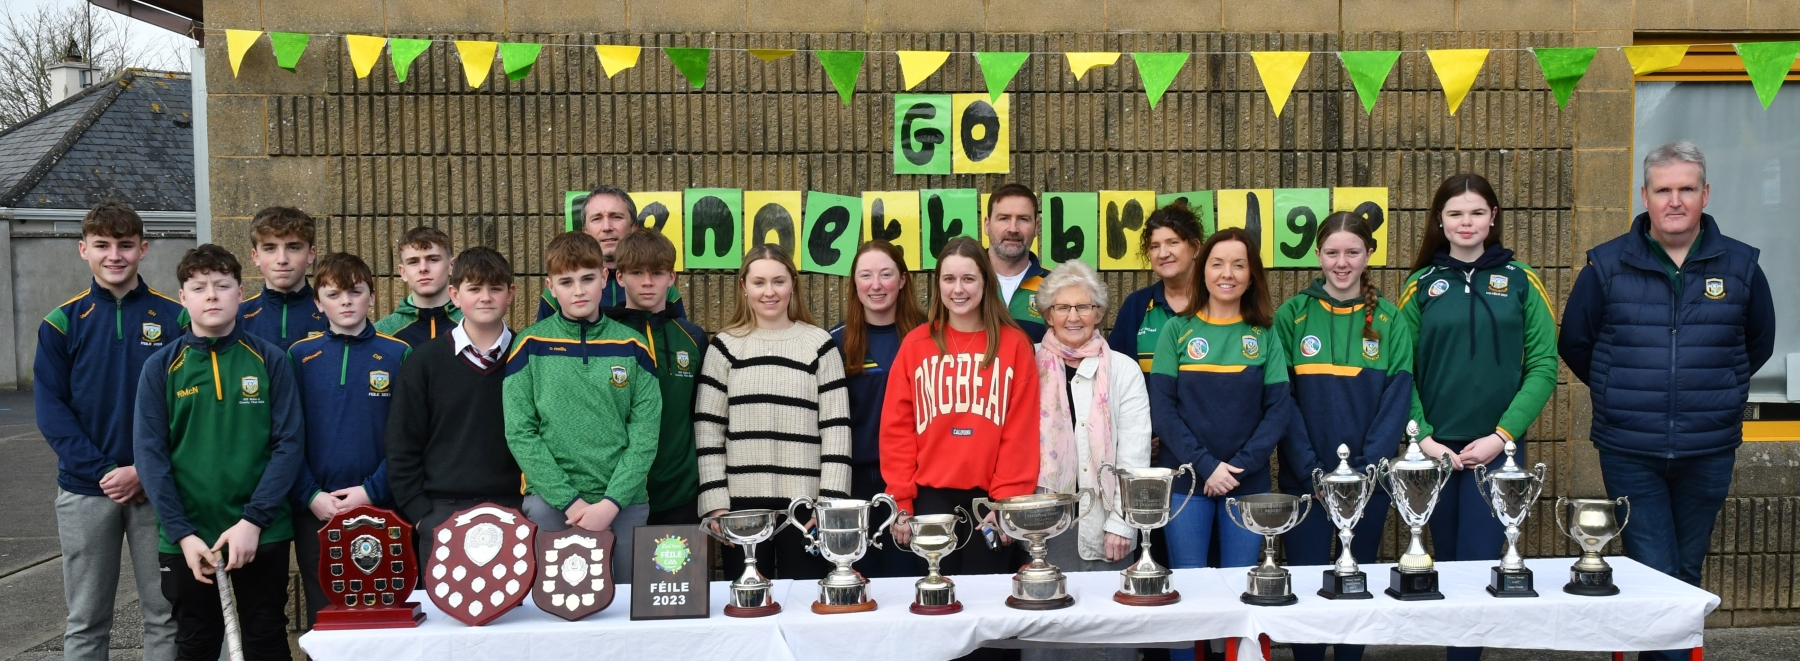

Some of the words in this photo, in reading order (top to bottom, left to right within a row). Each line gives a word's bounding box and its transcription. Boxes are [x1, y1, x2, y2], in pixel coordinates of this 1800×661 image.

[660, 550, 683, 559] FÉILE
[650, 580, 690, 594] FÉILE
[652, 594, 686, 606] 2023
